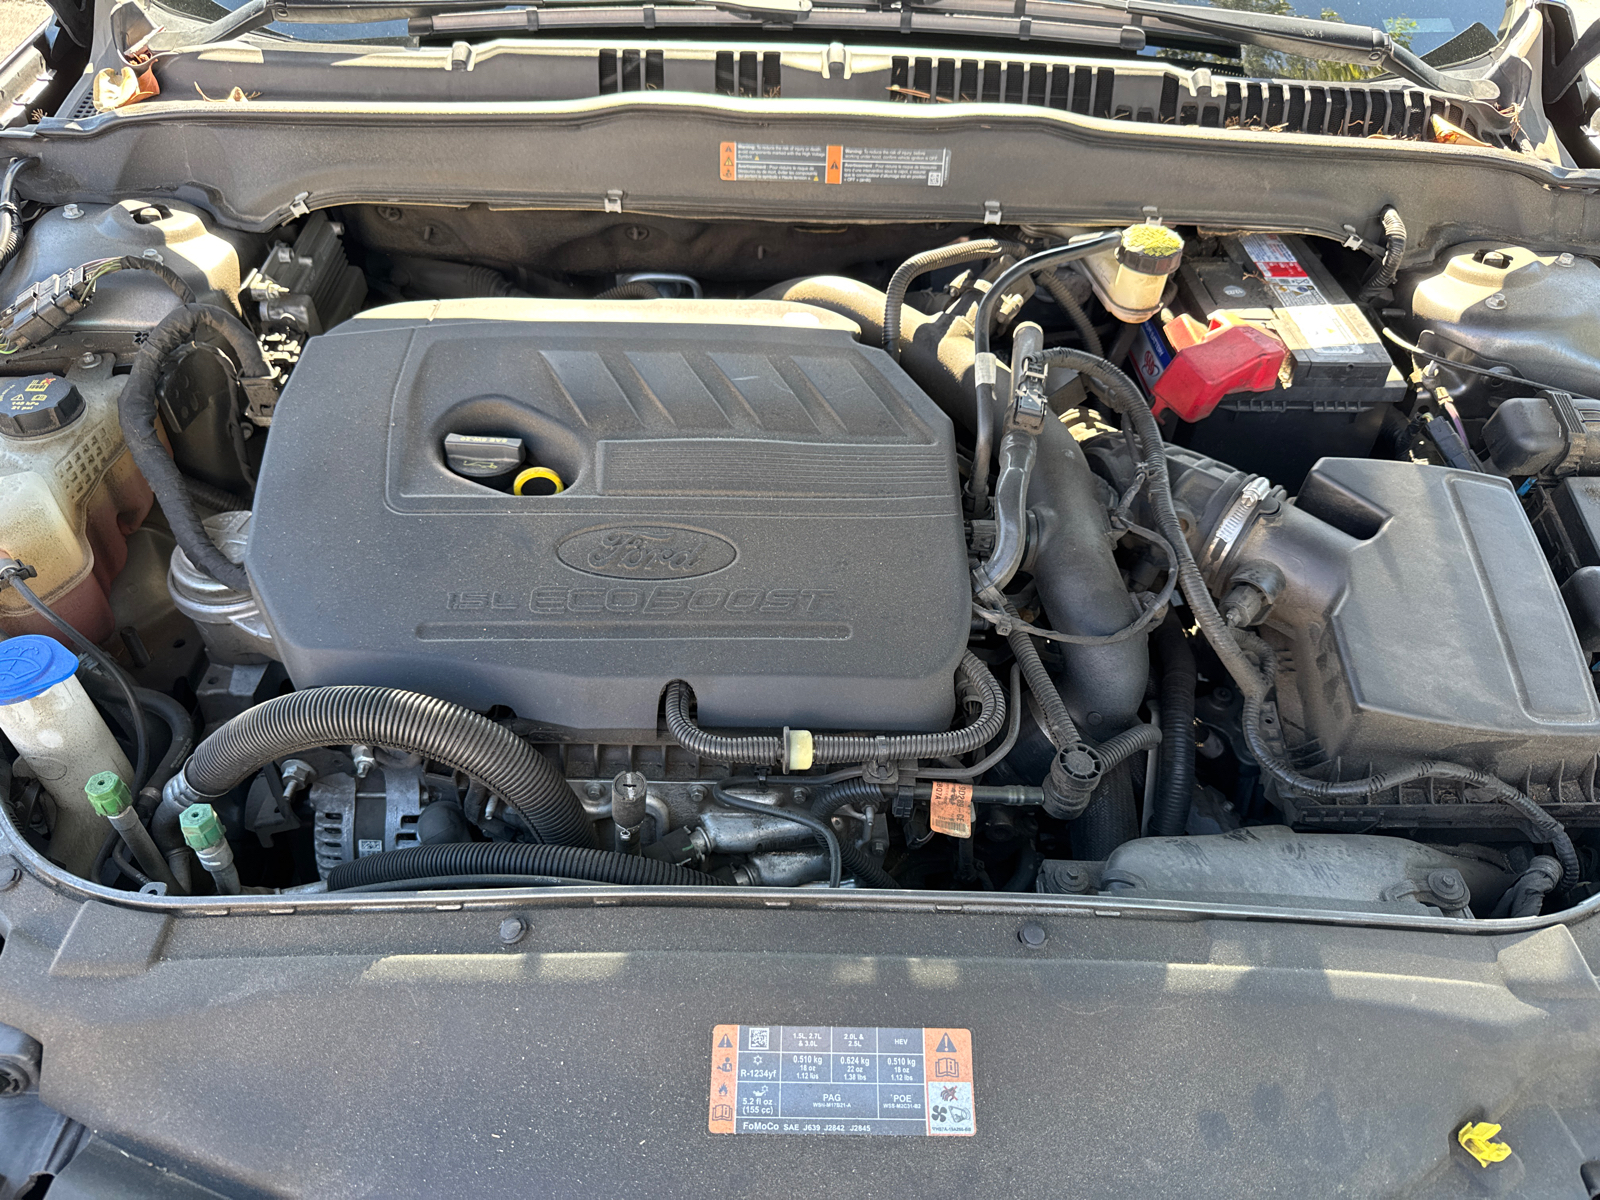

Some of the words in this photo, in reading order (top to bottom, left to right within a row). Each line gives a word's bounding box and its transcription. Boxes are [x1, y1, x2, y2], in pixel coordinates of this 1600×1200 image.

[588, 530, 708, 571] Ford
[793, 1055, 812, 1064] 0.510
[813, 1055, 823, 1066] kg
[840, 1056, 859, 1065] 0.624
[860, 1056, 870, 1067] kg
[887, 1057, 905, 1066] 0.510
[906, 1057, 916, 1067] kg
[740, 1069, 777, 1080] R-1234yf
[742, 1097, 754, 1105] 5.2
[823, 1093, 842, 1102] PAG
[893, 1094, 912, 1103] POE
[742, 1106, 760, 1115] (155
[761, 1106, 774, 1115] cc)
[742, 1122, 779, 1131] FoMoCo
